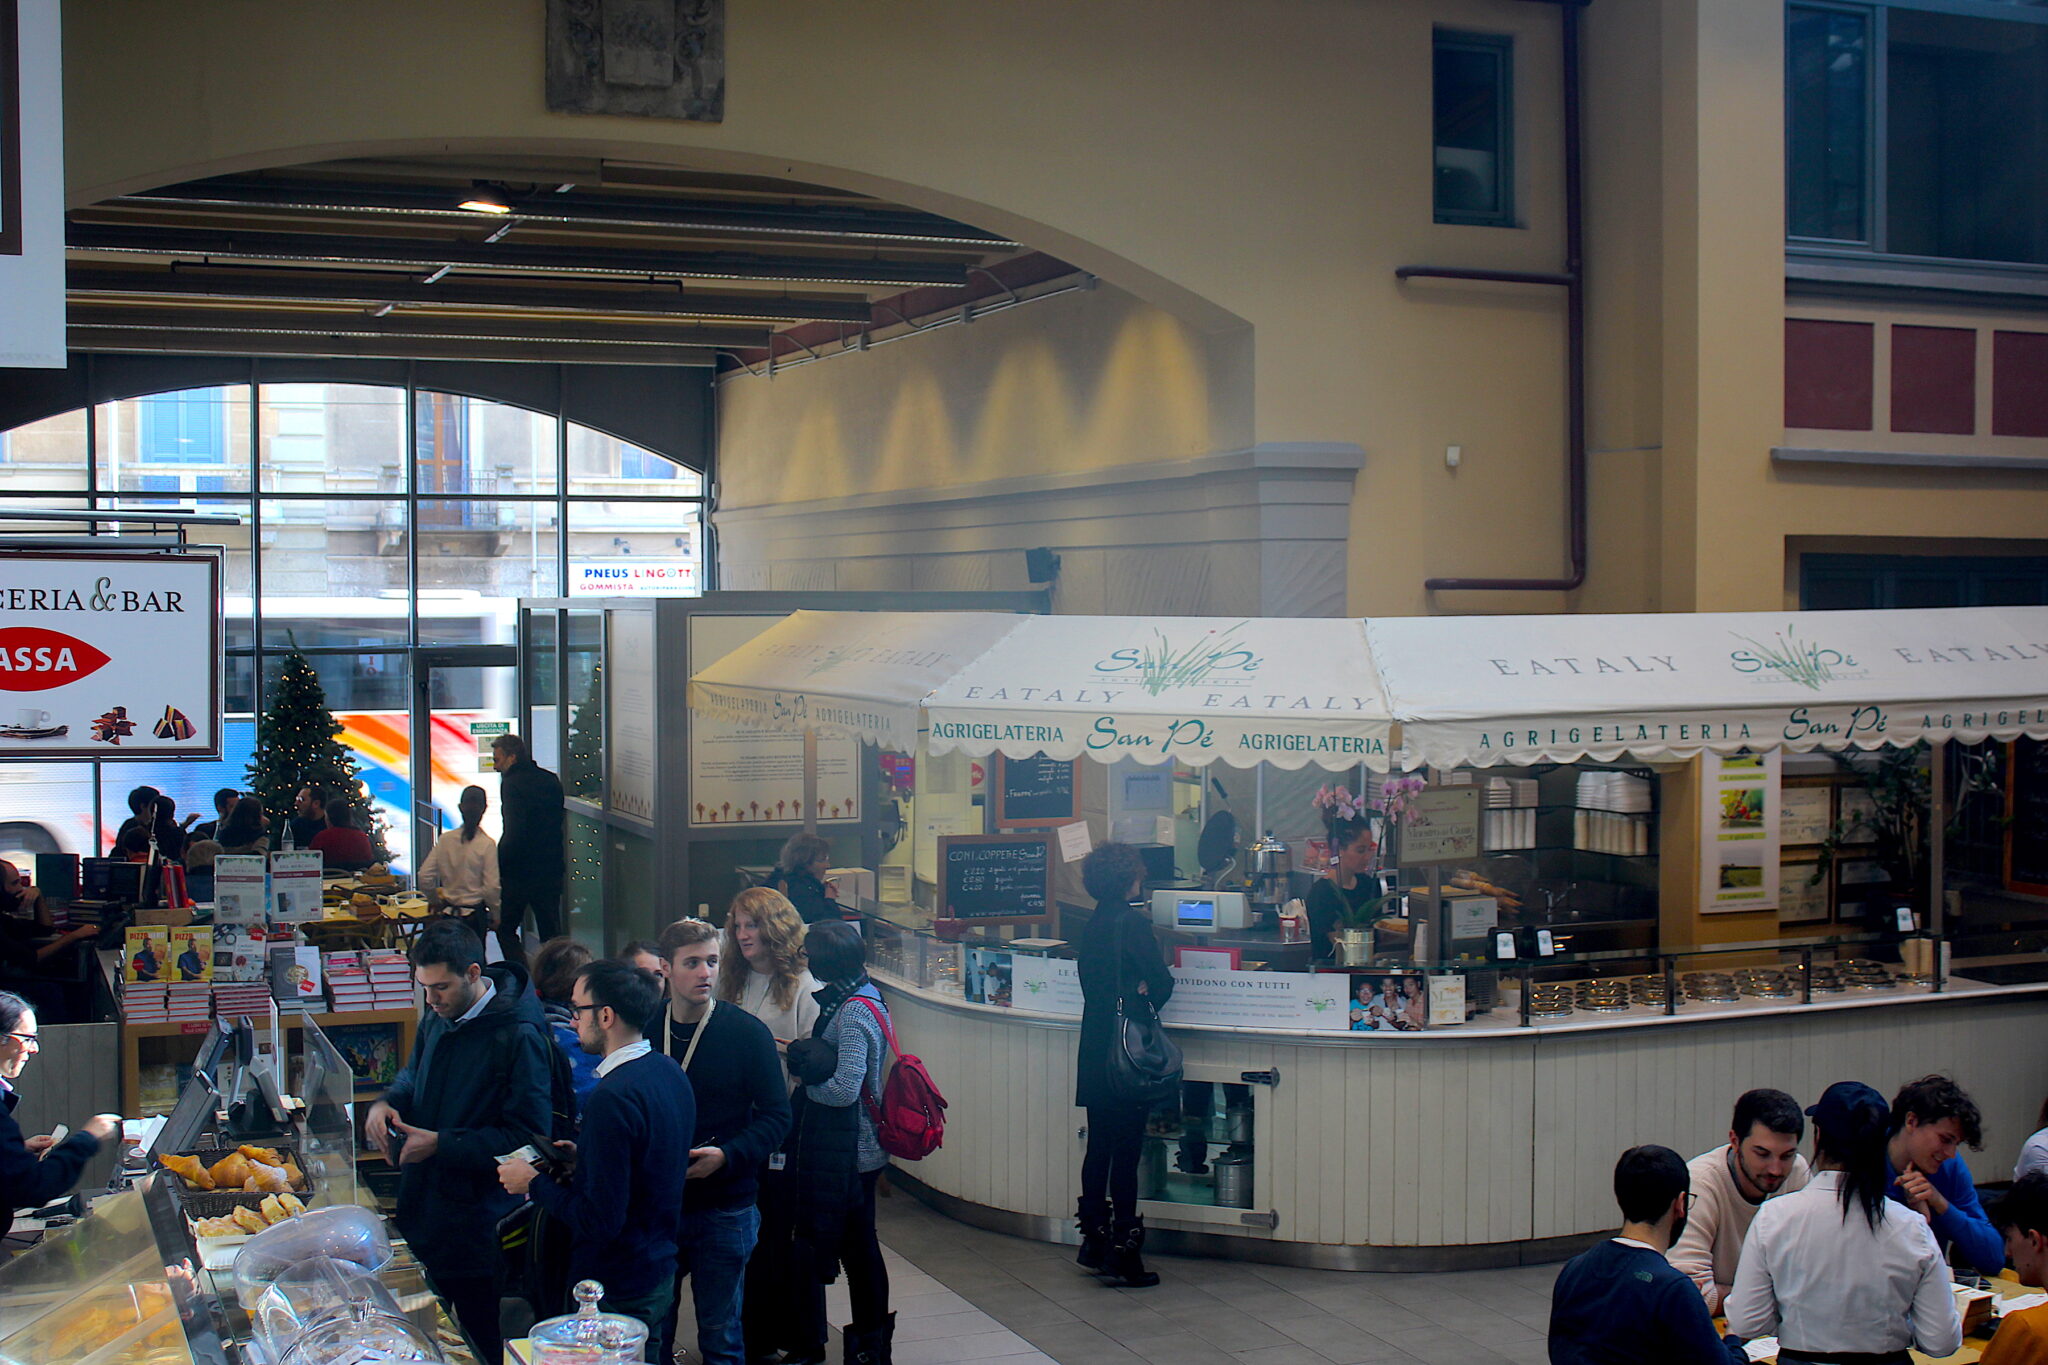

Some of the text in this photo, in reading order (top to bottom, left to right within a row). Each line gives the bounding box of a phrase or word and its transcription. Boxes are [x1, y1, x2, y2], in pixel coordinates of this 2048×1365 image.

[584, 568, 629, 578] PNEUS
[0, 588, 86, 611] ERIA
[121, 591, 185, 613] BAR
[1488, 655, 1679, 676] EATALY
[965, 686, 1374, 711] EATALY EATALY
[815, 706, 891, 731] AGRIGELATERIA
[1479, 723, 1750, 749] AGRIGELATERIA
[1783, 706, 1839, 741] San
[1845, 705, 1888, 740] Pé
[932, 716, 1384, 755] AGRIGELATERIA San Pé AGRIGELATERIA
[1231, 980, 1252, 988] CON
[1258, 981, 1290, 990] TUTTI
